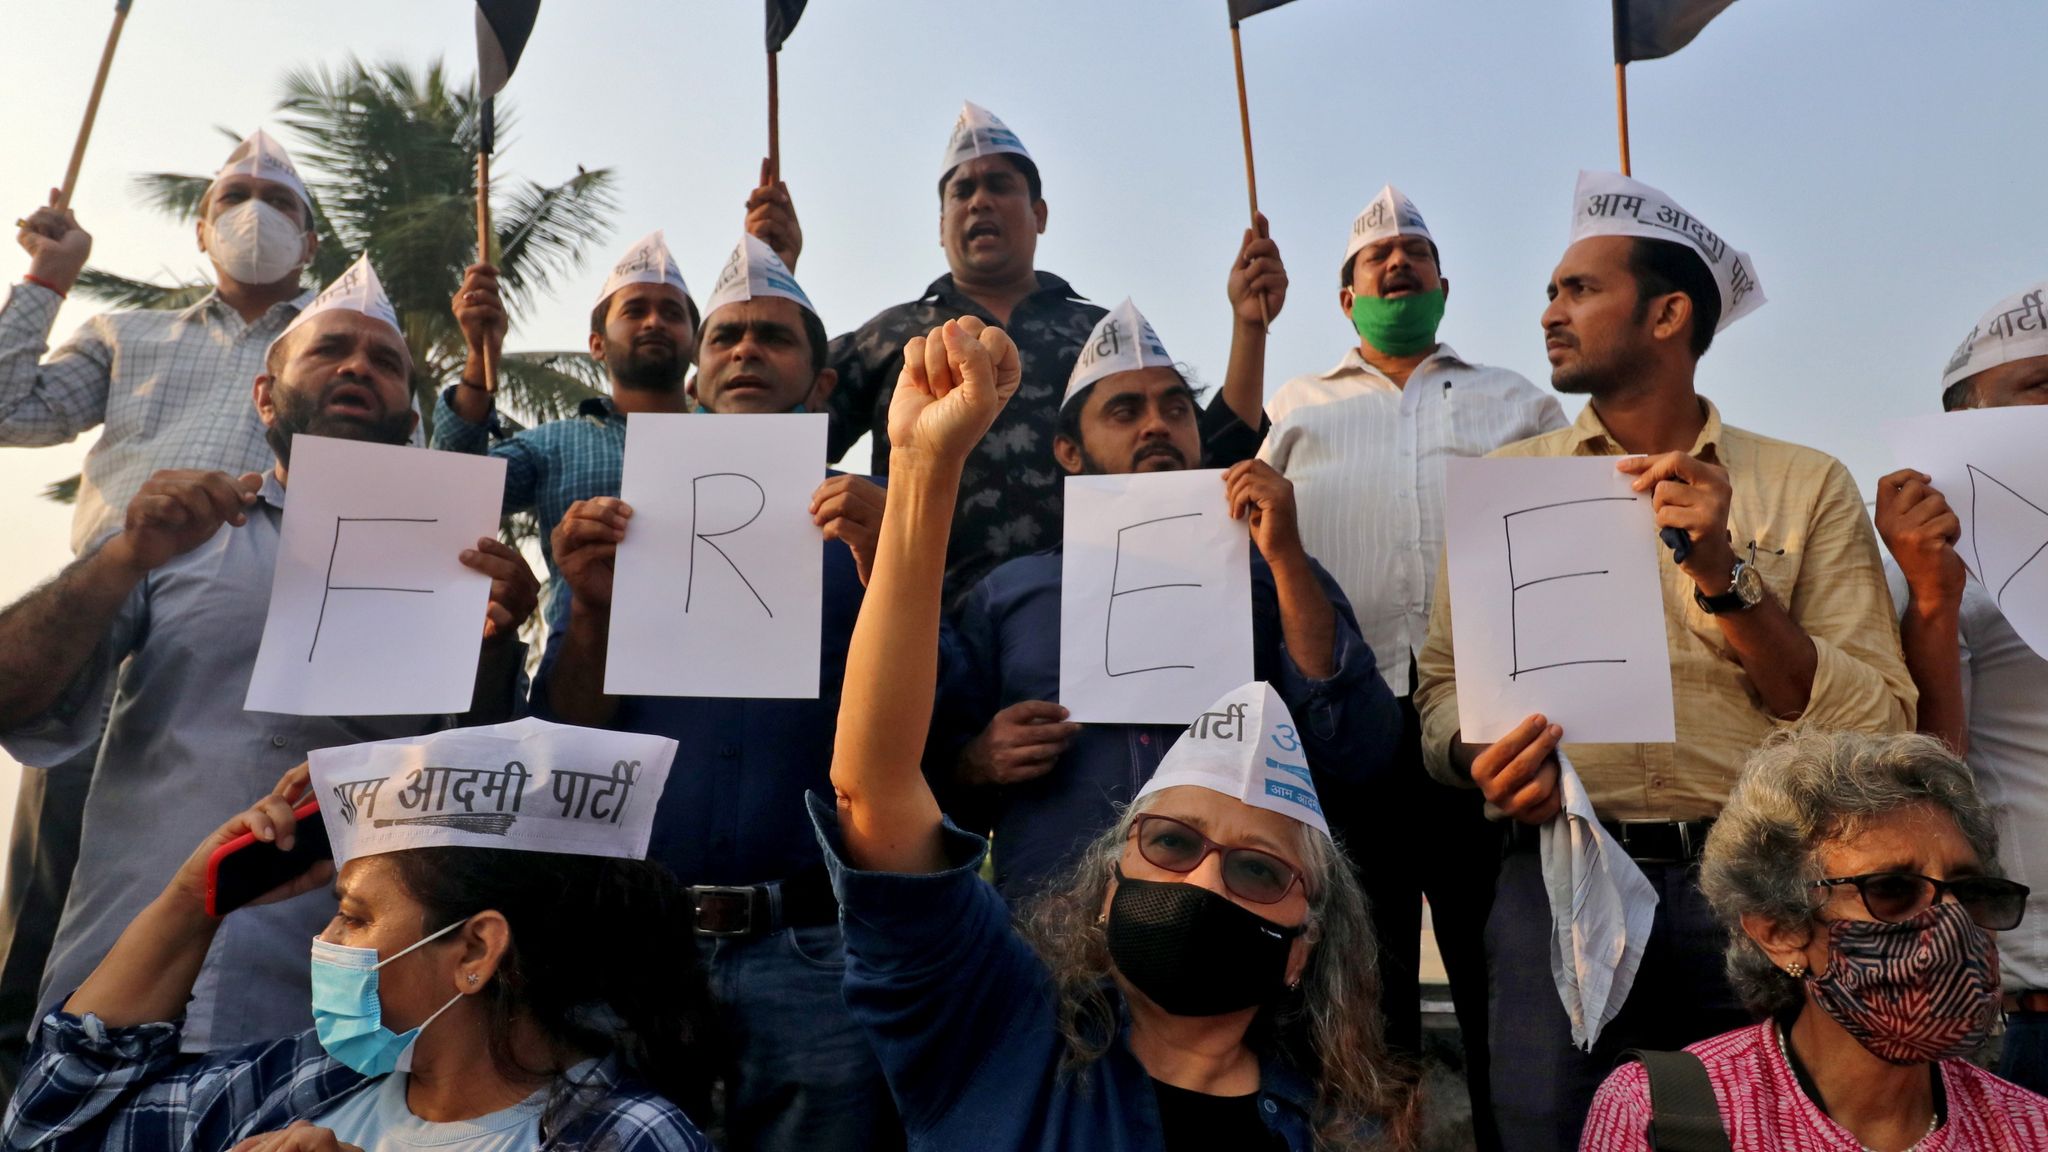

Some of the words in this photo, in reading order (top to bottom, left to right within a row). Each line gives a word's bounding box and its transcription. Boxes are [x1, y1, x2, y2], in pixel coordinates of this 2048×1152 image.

[1587, 193, 1646, 218] आम
[1988, 289, 2048, 340] पार्टी
[308, 515, 438, 662] F
[685, 472, 773, 618] R
[1105, 512, 1203, 678] E
[1502, 497, 1638, 682] E
[333, 776, 391, 826] आम
[398, 760, 533, 813] आदमी
[551, 759, 642, 824] पार्टी
[1271, 784, 1294, 799] आम
